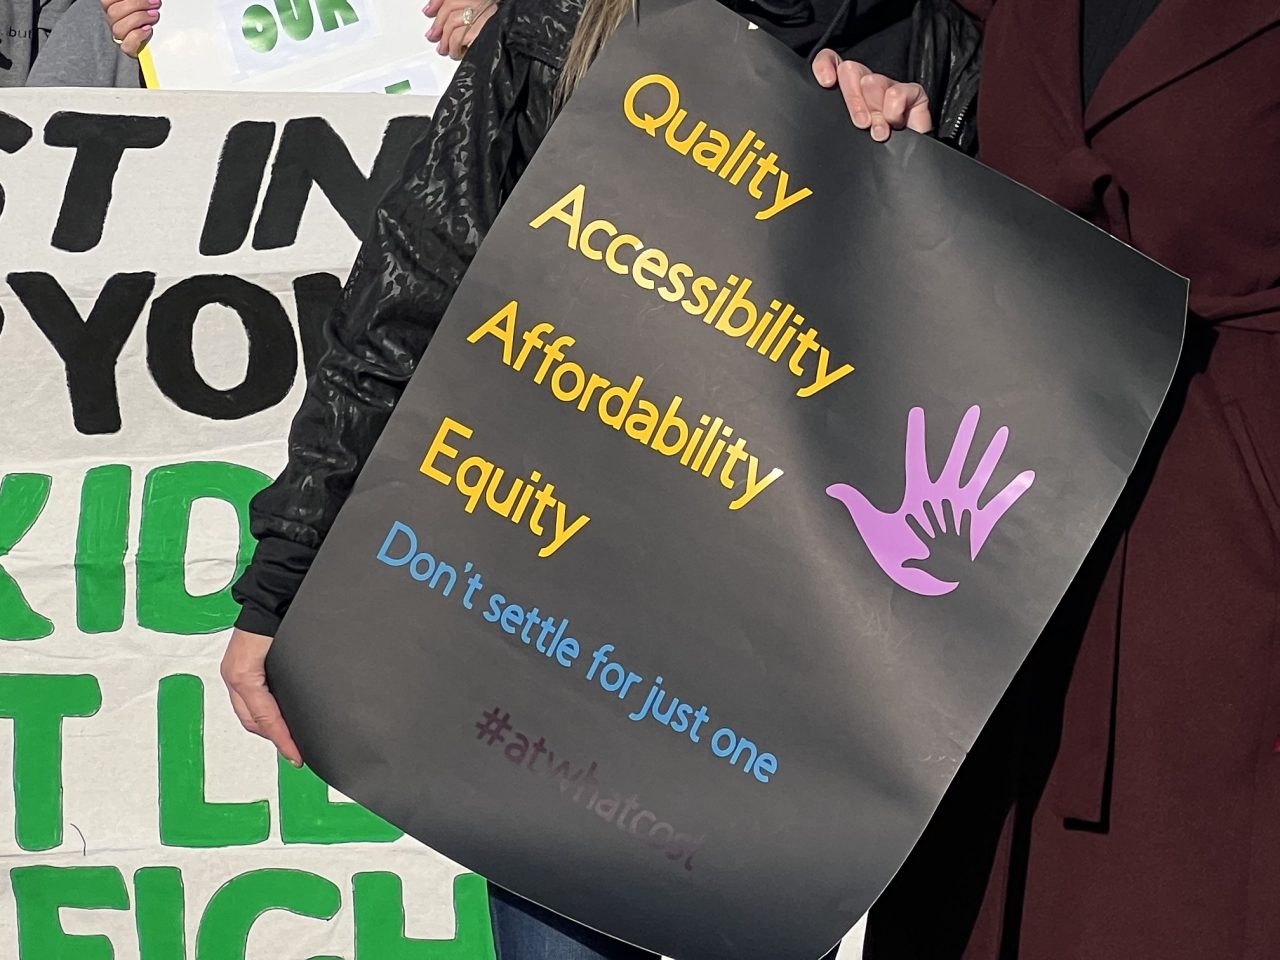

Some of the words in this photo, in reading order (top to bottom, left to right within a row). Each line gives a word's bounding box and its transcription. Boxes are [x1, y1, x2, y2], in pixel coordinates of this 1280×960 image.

[623, 74, 813, 220] Quality
[529, 184, 855, 398] Accessibility
[419, 417, 590, 558] Equity
[466, 301, 784, 510] Affordability
[376, 521, 483, 610] Don't
[482, 592, 581, 668] settle
[585, 643, 644, 700] for
[628, 676, 710, 744] just
[711, 727, 779, 784] one
